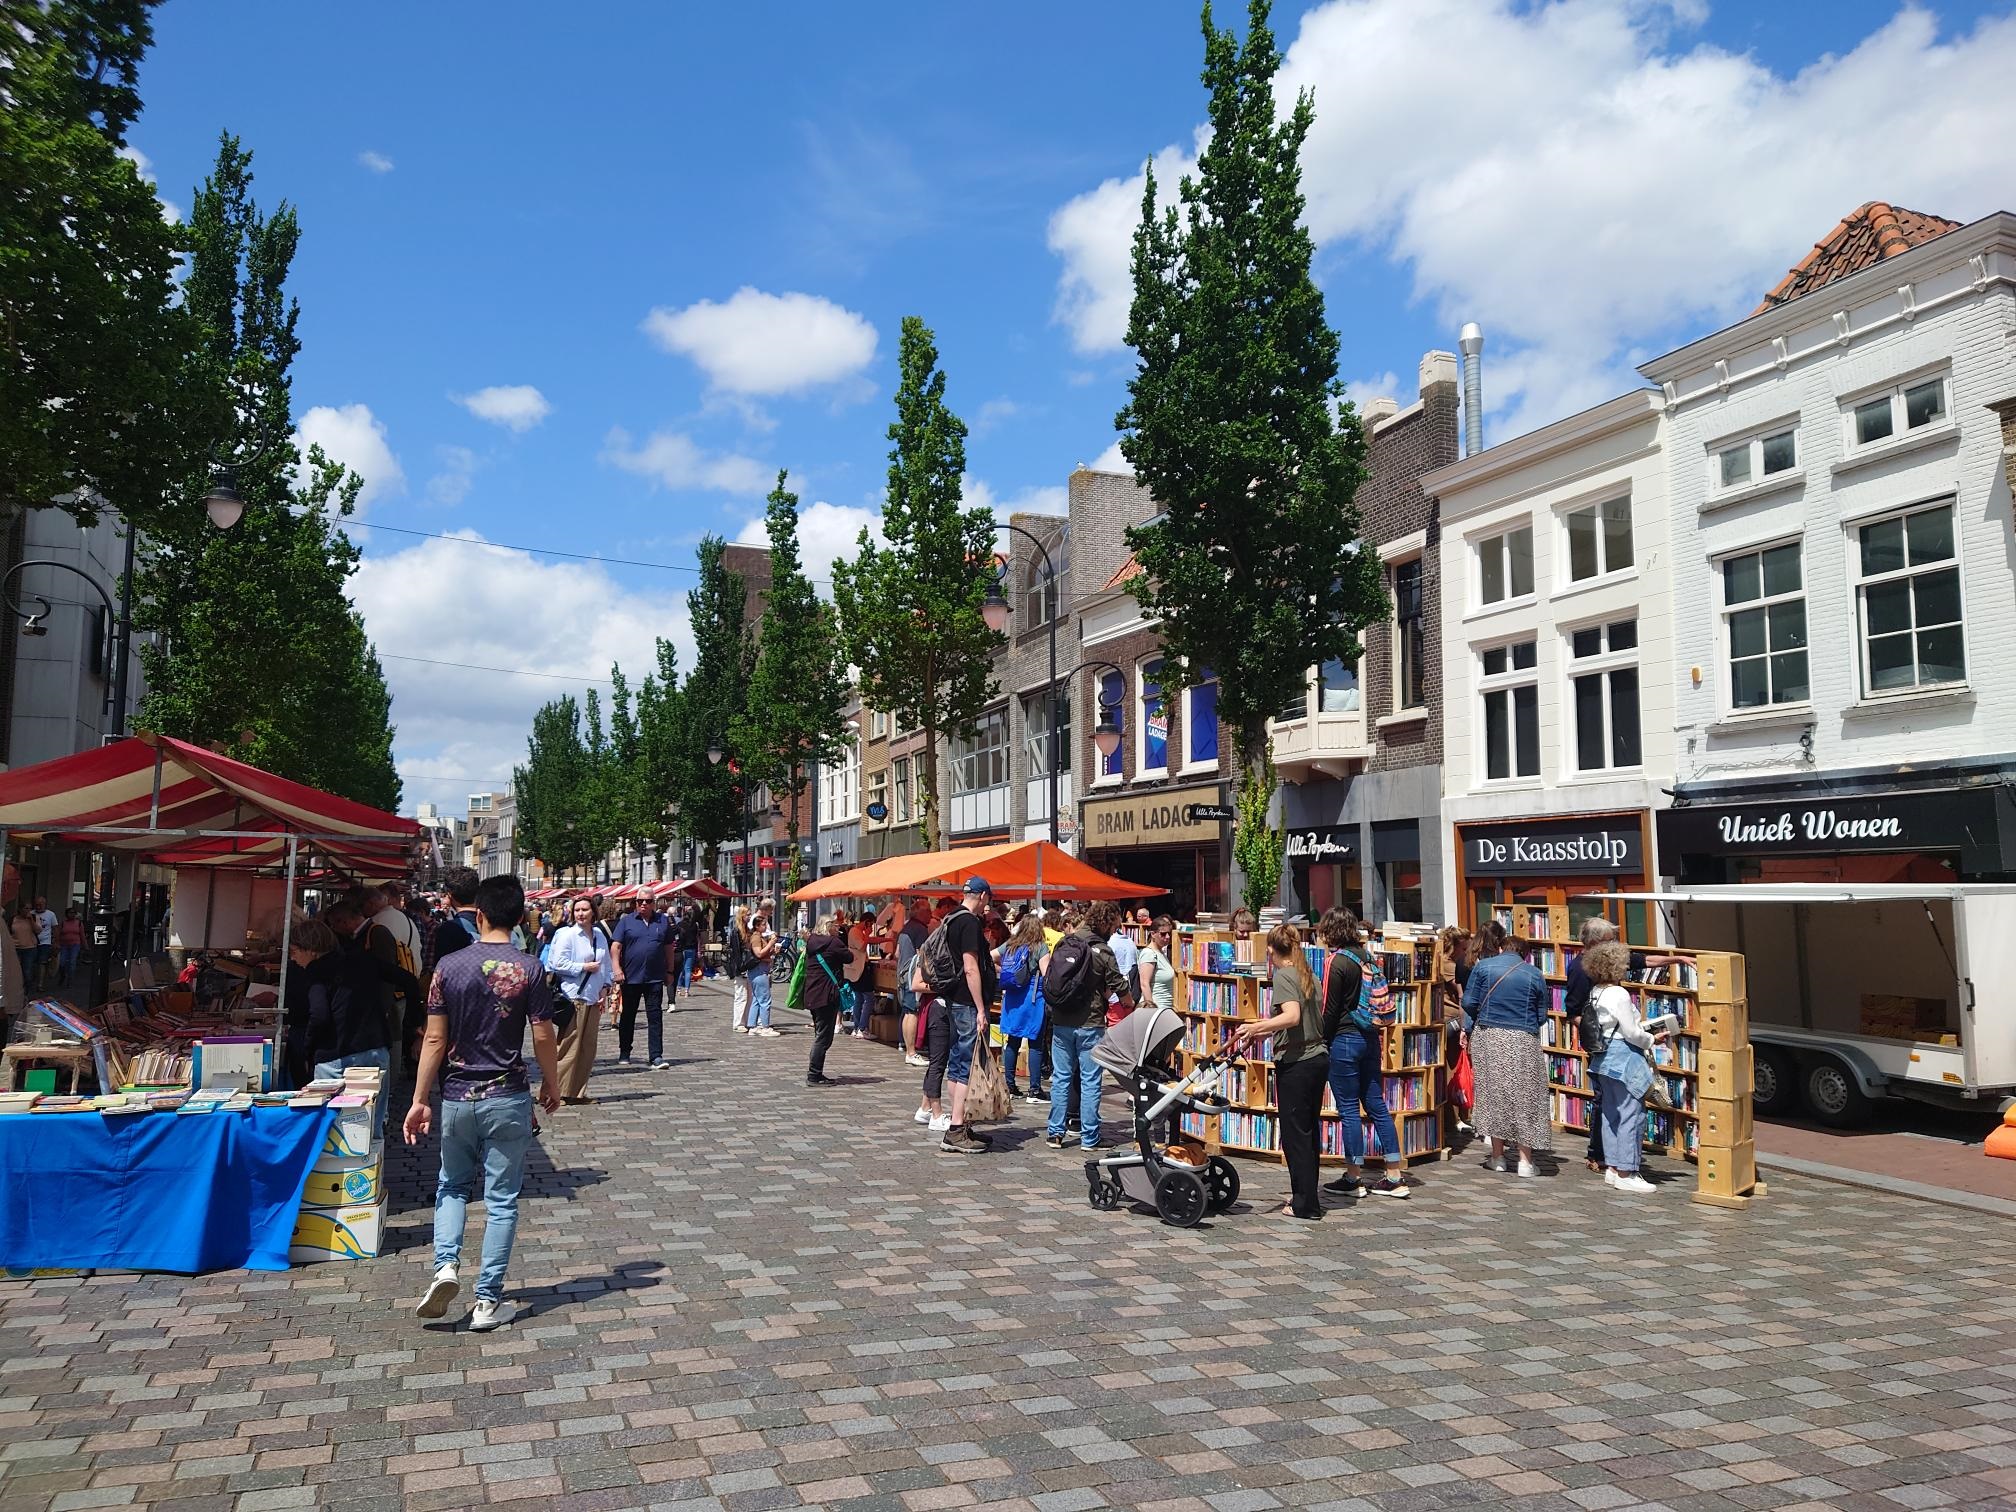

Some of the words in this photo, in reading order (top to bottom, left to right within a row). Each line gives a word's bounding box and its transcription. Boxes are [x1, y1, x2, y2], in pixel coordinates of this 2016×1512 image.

[1097, 810, 1134, 835] BRAM
[1718, 812, 1796, 843] Uniek
[1800, 810, 1902, 840] Wonen
[1286, 833, 1307, 856] Ulla
[1307, 831, 1350, 862] Popken
[1477, 838, 1507, 863] De
[1511, 831, 1627, 867] Kaasstolp
